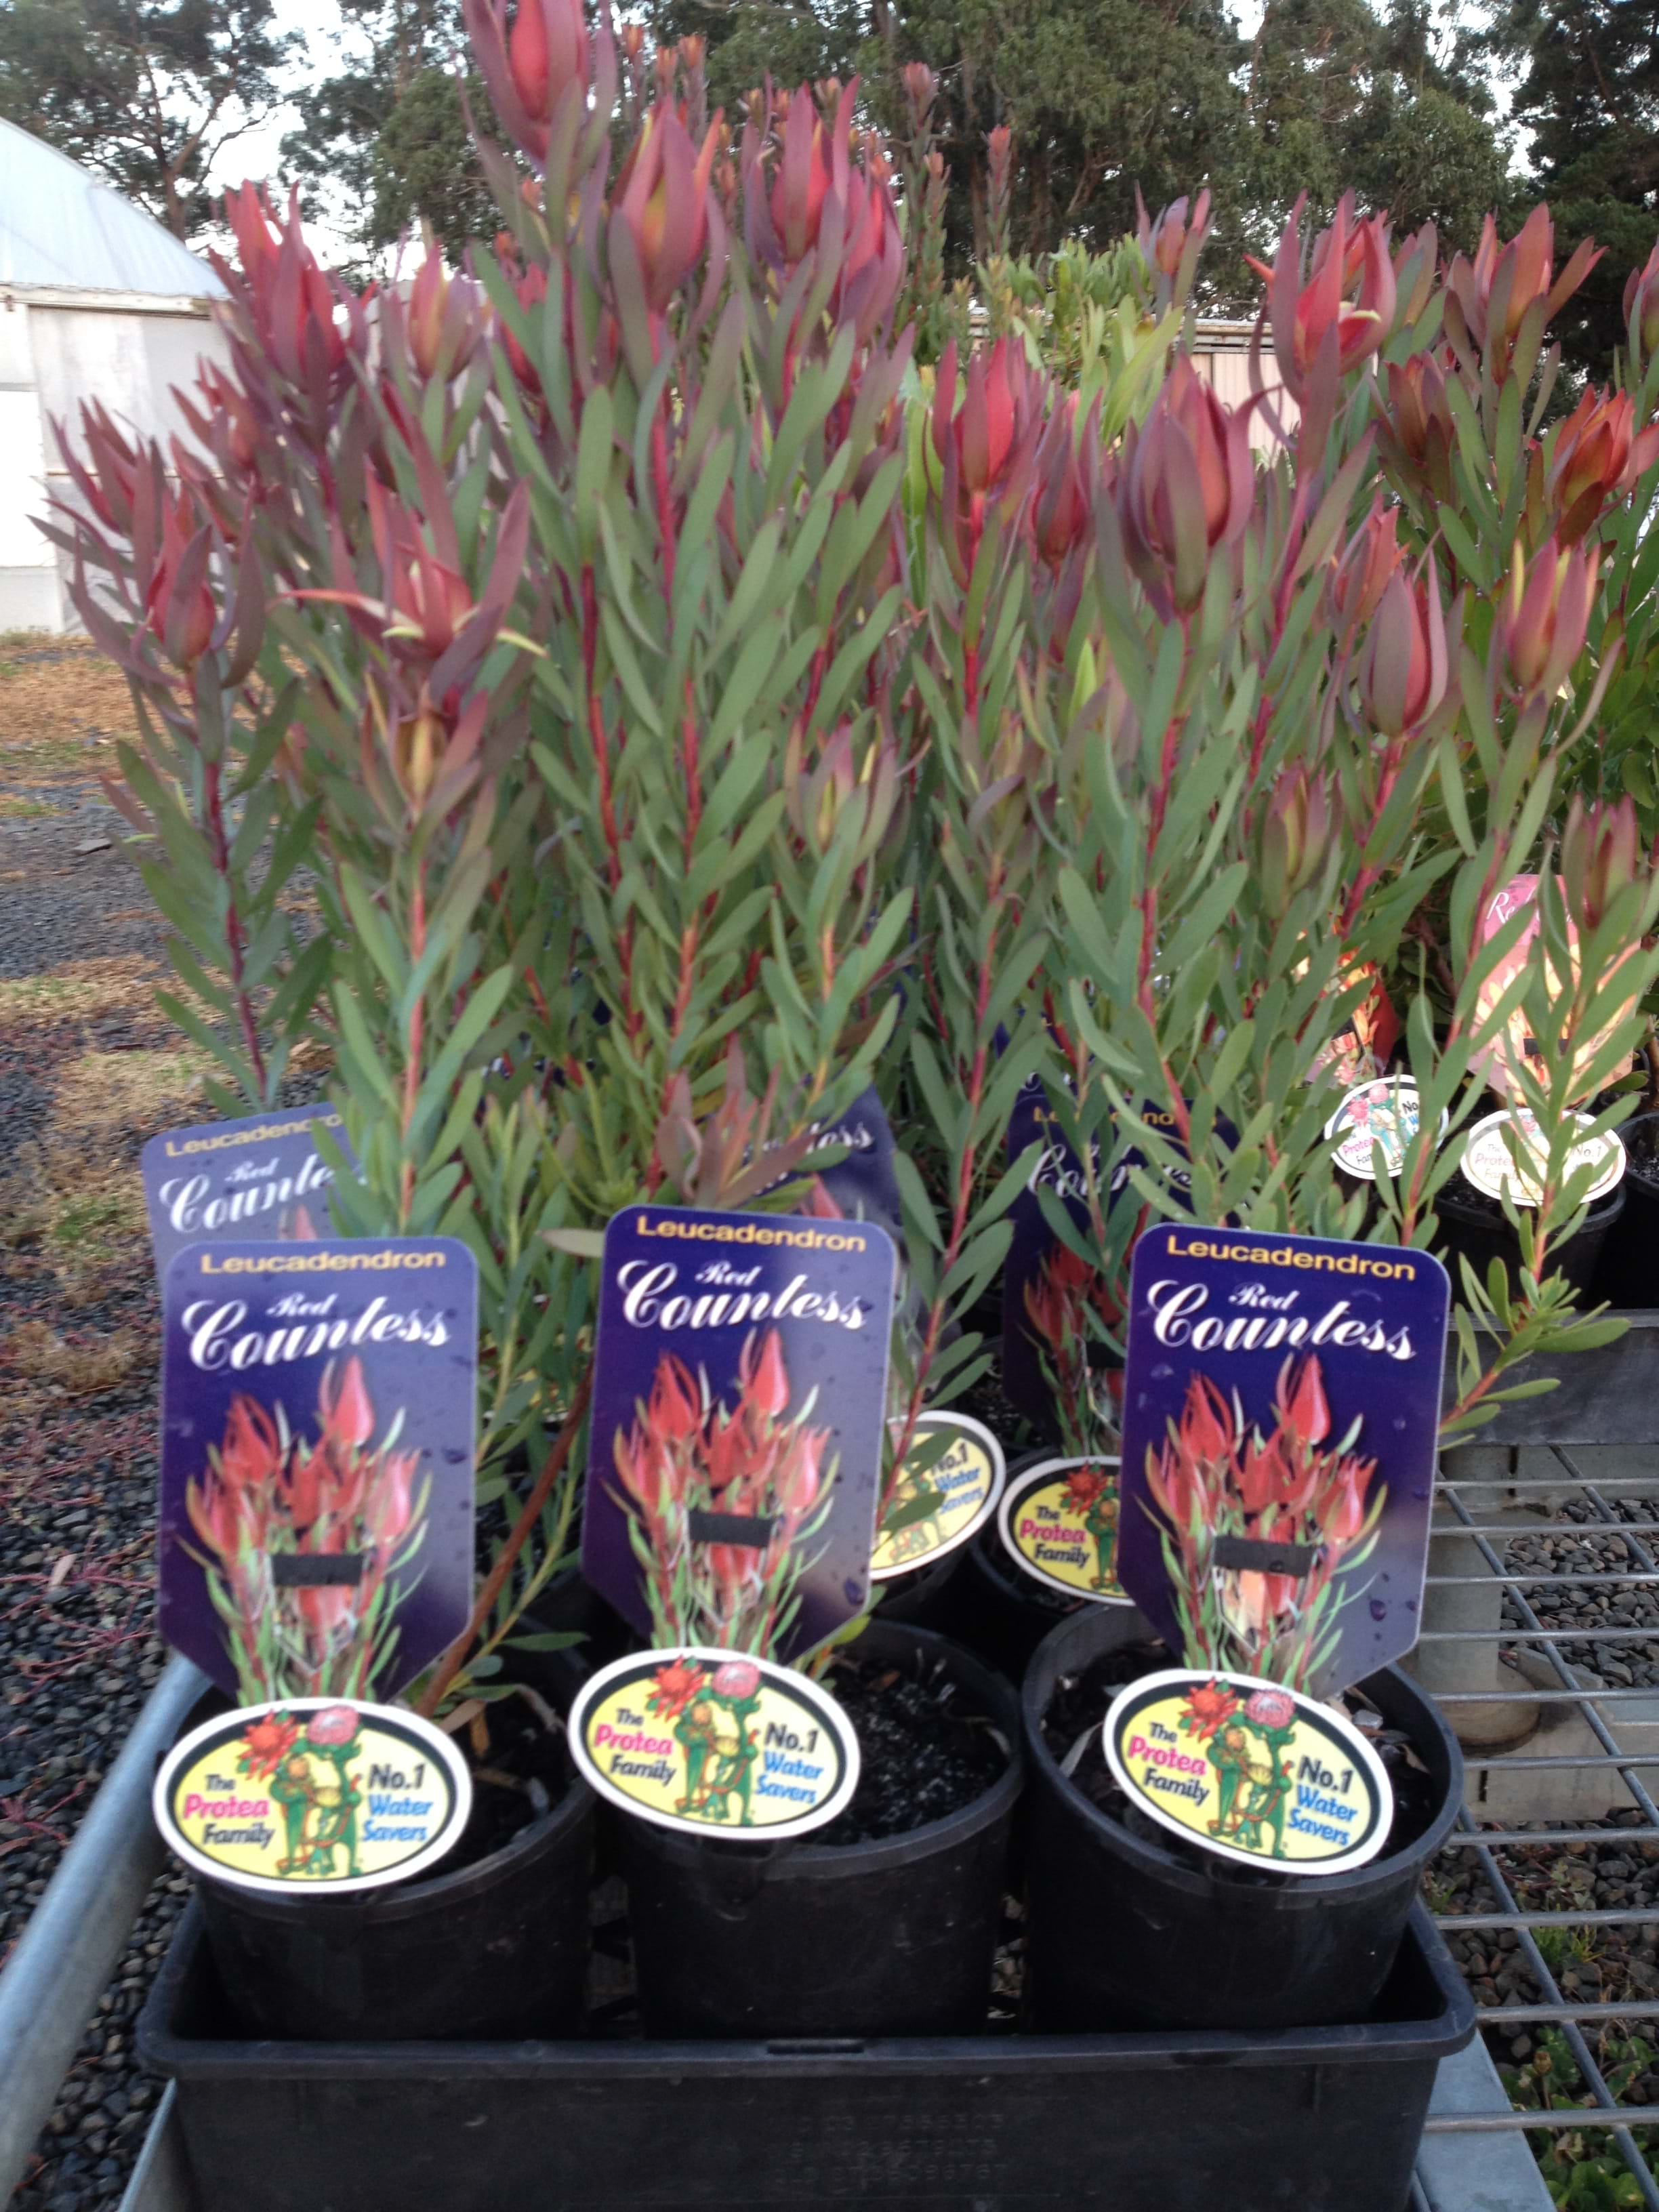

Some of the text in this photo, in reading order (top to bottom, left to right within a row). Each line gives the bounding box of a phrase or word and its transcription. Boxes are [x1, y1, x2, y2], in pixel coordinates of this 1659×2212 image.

[224, 1158, 279, 1182] Red
[637, 1215, 867, 1252] Leucadendron
[201, 1250, 446, 1274] Leucadendron
[1167, 1235, 1416, 1281] Leucadendron
[695, 1261, 763, 1286] Red
[266, 1292, 337, 1318] Red
[1228, 1282, 1300, 1310] Red
[935, 1466, 980, 1493] Water
[1036, 1505, 1060, 1521] The
[1020, 1519, 1086, 1544] Protea
[1034, 1543, 1090, 1569] Family
[617, 1708, 644, 1727] The
[594, 1724, 674, 1755] Protea
[764, 1722, 819, 1753] No.1
[1149, 1721, 1177, 1743] The
[762, 1751, 824, 1781] Water
[1128, 1735, 1207, 1776] Protea
[206, 1774, 236, 1792] The
[368, 1763, 426, 1790] No.1
[610, 1755, 676, 1788] Family
[1298, 1755, 1354, 1794] No.1
[754, 1775, 817, 1805] Savers
[1143, 1767, 1210, 1807] Family
[183, 1794, 270, 1820] Protea
[369, 1795, 433, 1816] Water
[1296, 1784, 1358, 1822] Water
[203, 1823, 275, 1849] Family
[362, 1820, 428, 1843] Savers
[1288, 1808, 1351, 1847] Savers
